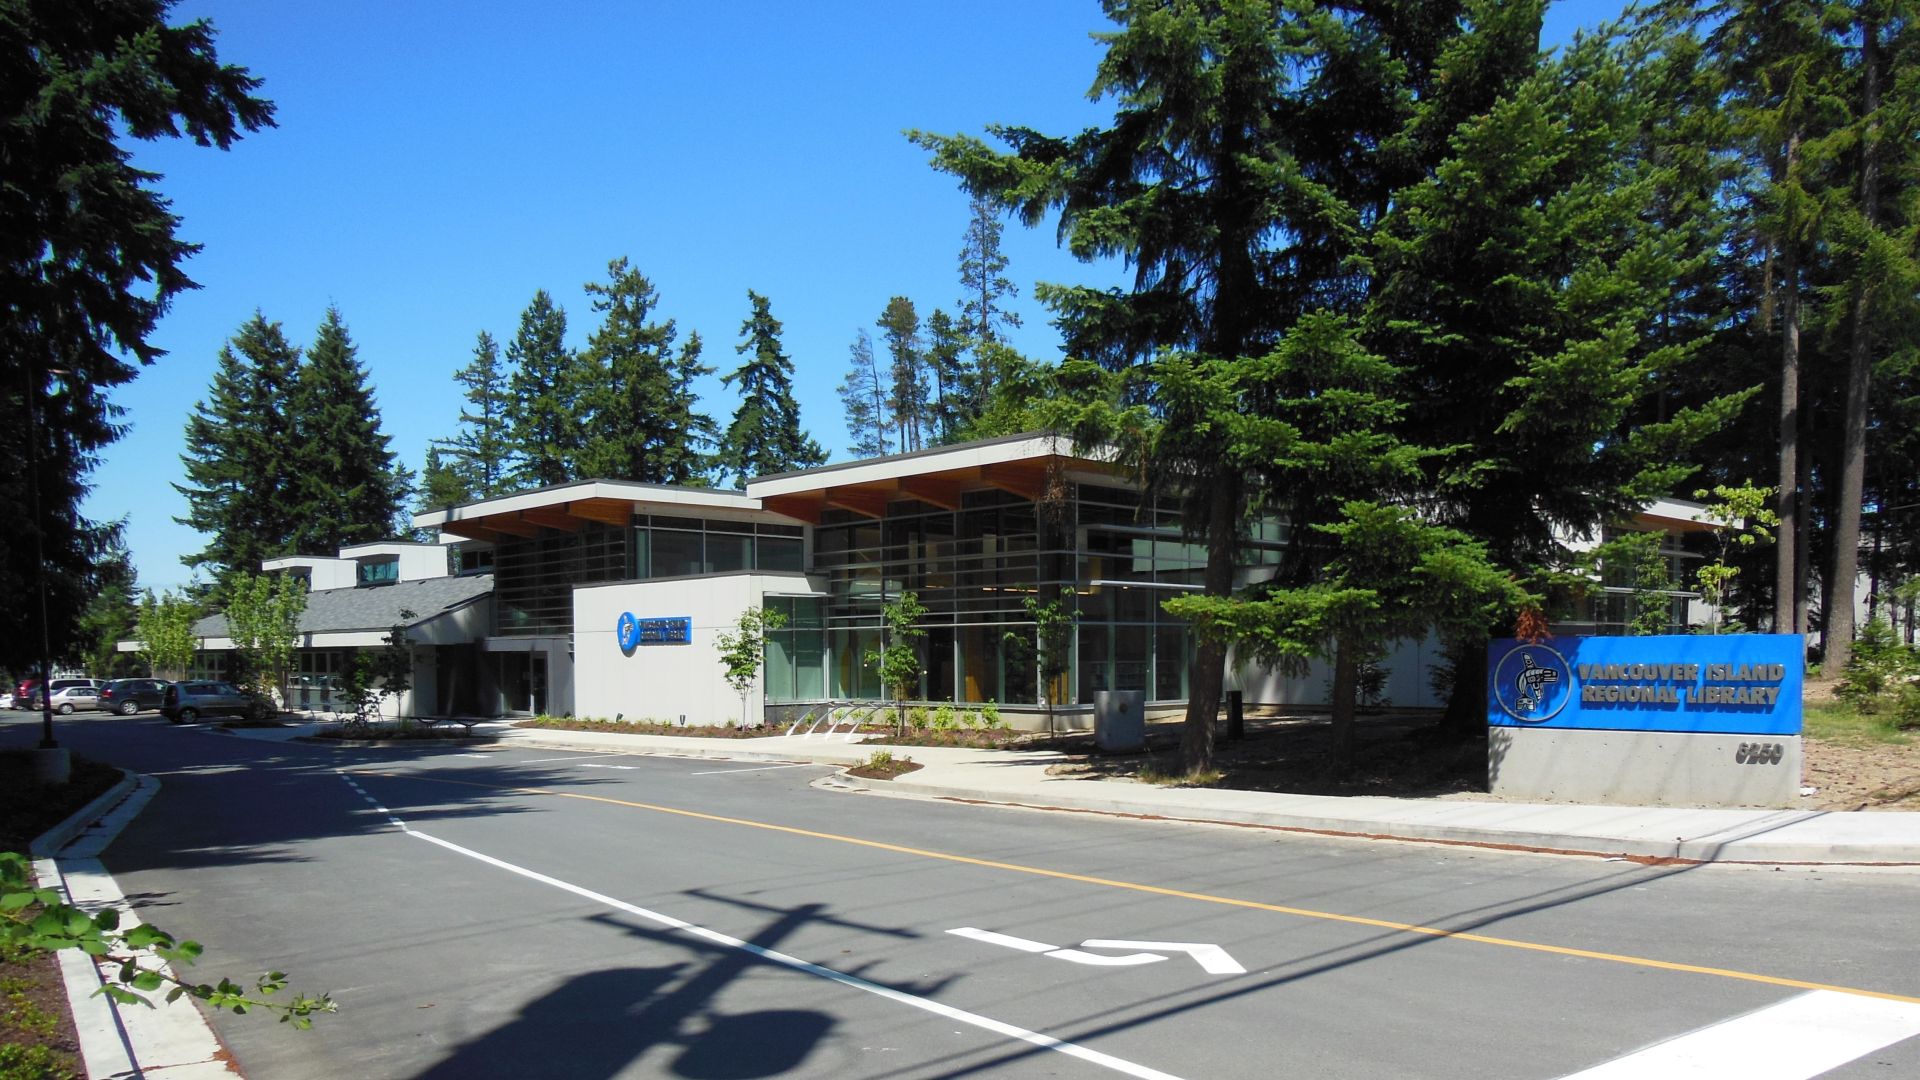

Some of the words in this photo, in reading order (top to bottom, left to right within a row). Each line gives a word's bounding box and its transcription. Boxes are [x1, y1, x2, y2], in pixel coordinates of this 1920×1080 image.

[1578, 663, 1699, 680] VANCOUVER
[1706, 663, 1785, 681] ISLAND
[1582, 685, 1679, 703] REGIONAL
[1686, 686, 1780, 704] LIBRARY
[1735, 742, 1784, 761] 6250
